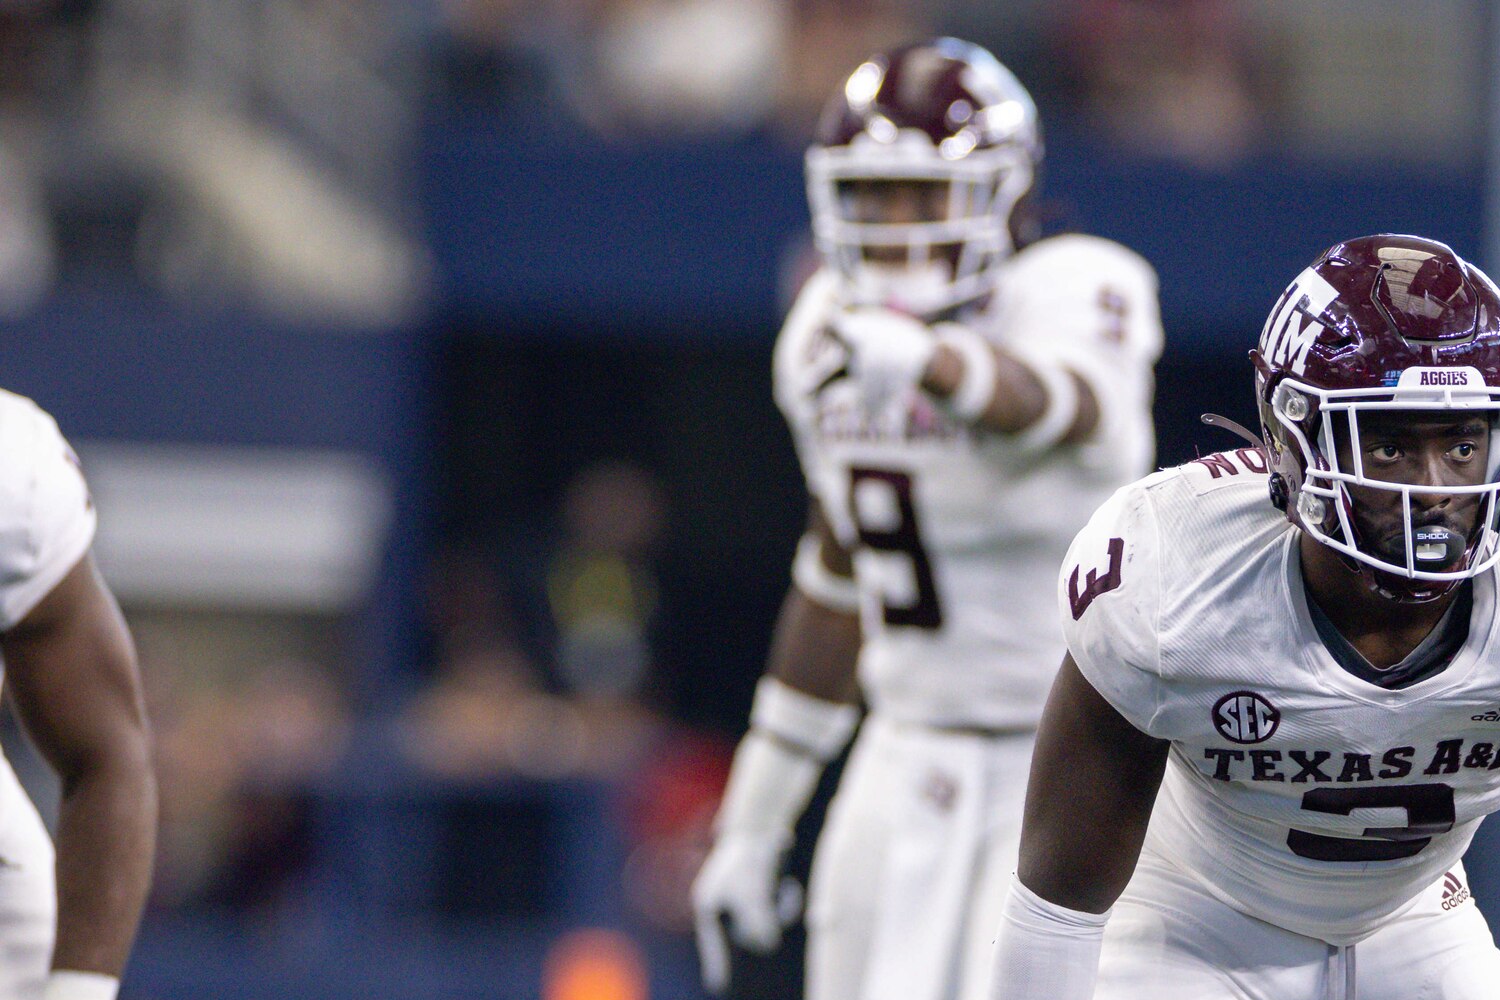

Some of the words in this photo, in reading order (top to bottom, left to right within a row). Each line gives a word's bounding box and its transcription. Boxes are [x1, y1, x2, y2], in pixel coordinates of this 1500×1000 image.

[1420, 371, 1468, 386] AGGIES
[852, 466, 942, 629] 9
[1216, 695, 1275, 741] SEC
[1204, 746, 1415, 783] TEXAS
[1287, 783, 1456, 861] 3
